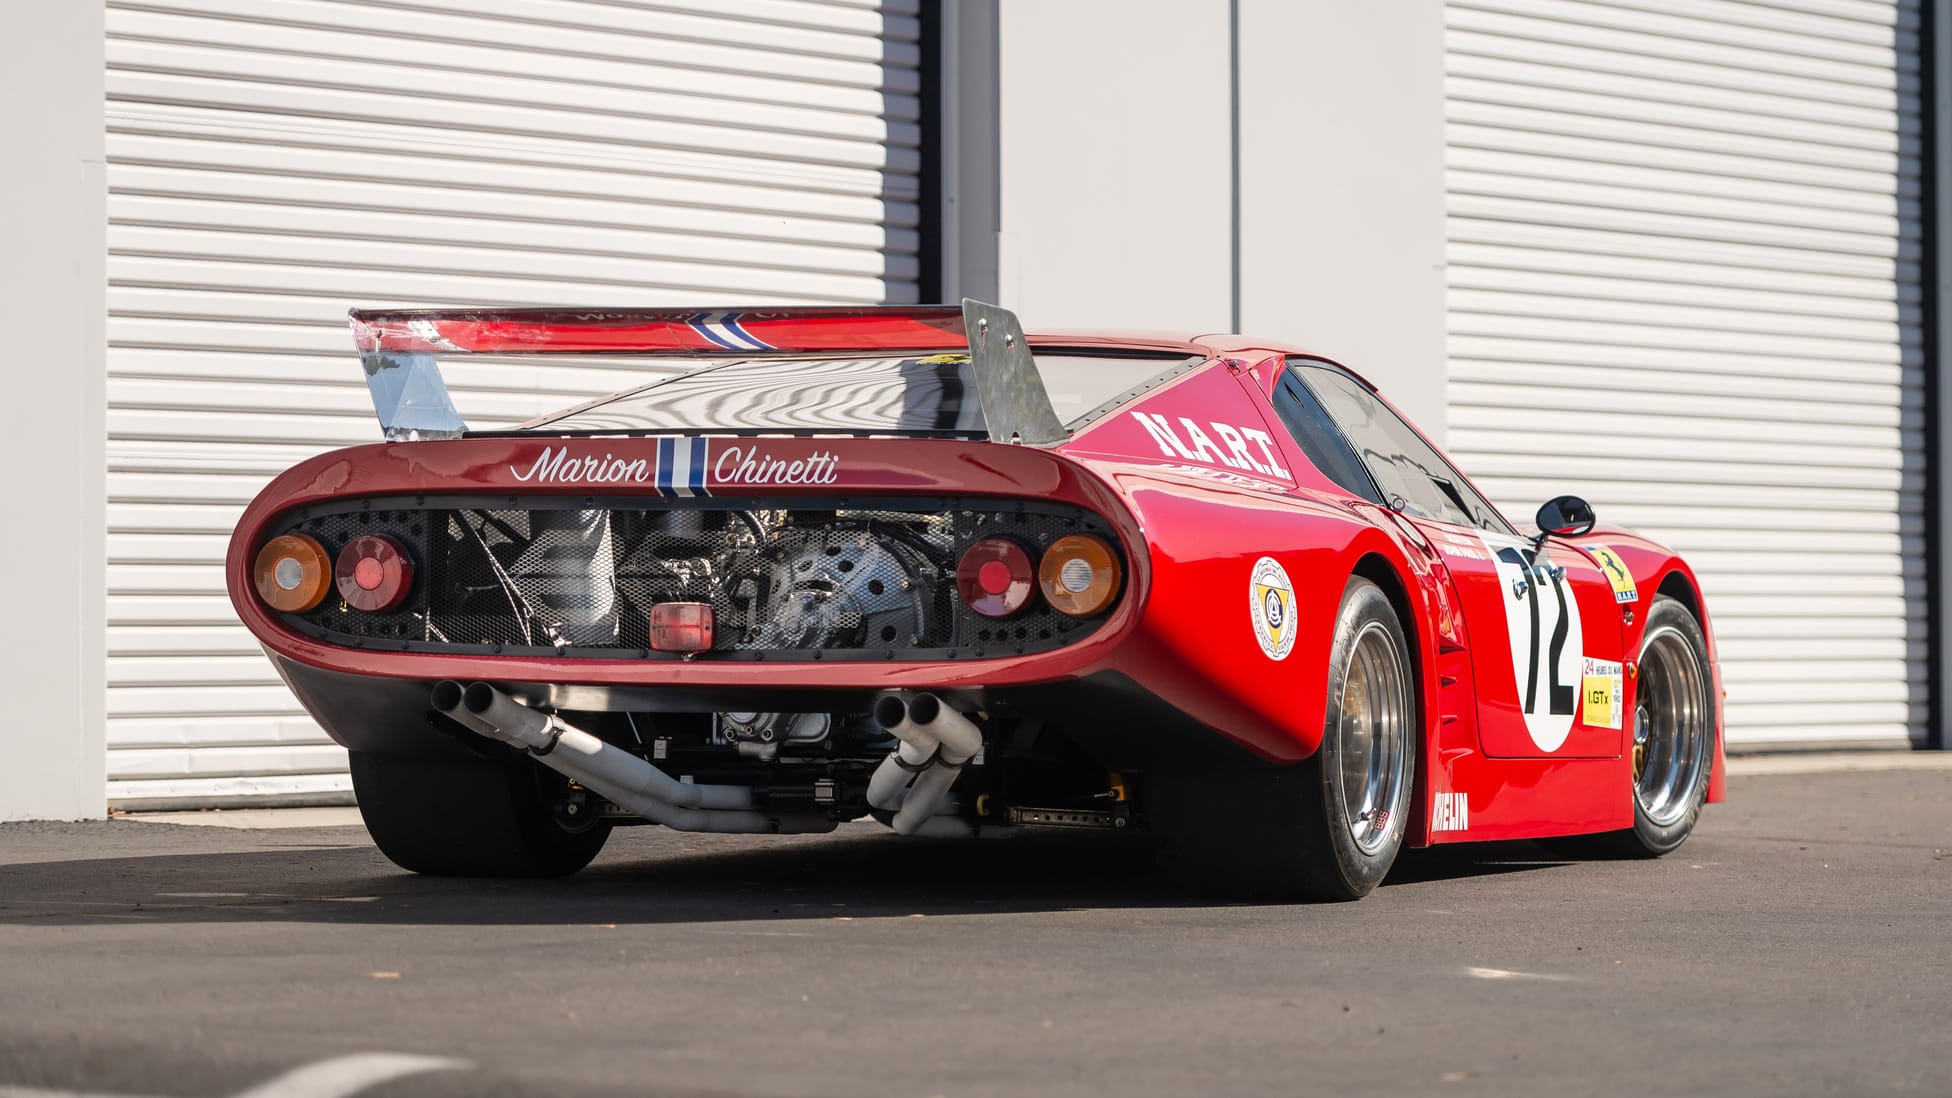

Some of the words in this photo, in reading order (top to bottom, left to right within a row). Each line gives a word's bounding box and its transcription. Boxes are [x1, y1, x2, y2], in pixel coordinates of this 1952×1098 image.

[510, 446, 649, 483] Marion
[714, 446, 839, 484] Chinetti
[1490, 545, 1575, 715] 72
[1585, 659, 1594, 675] 24
[1375, 810, 1389, 829] BBS
